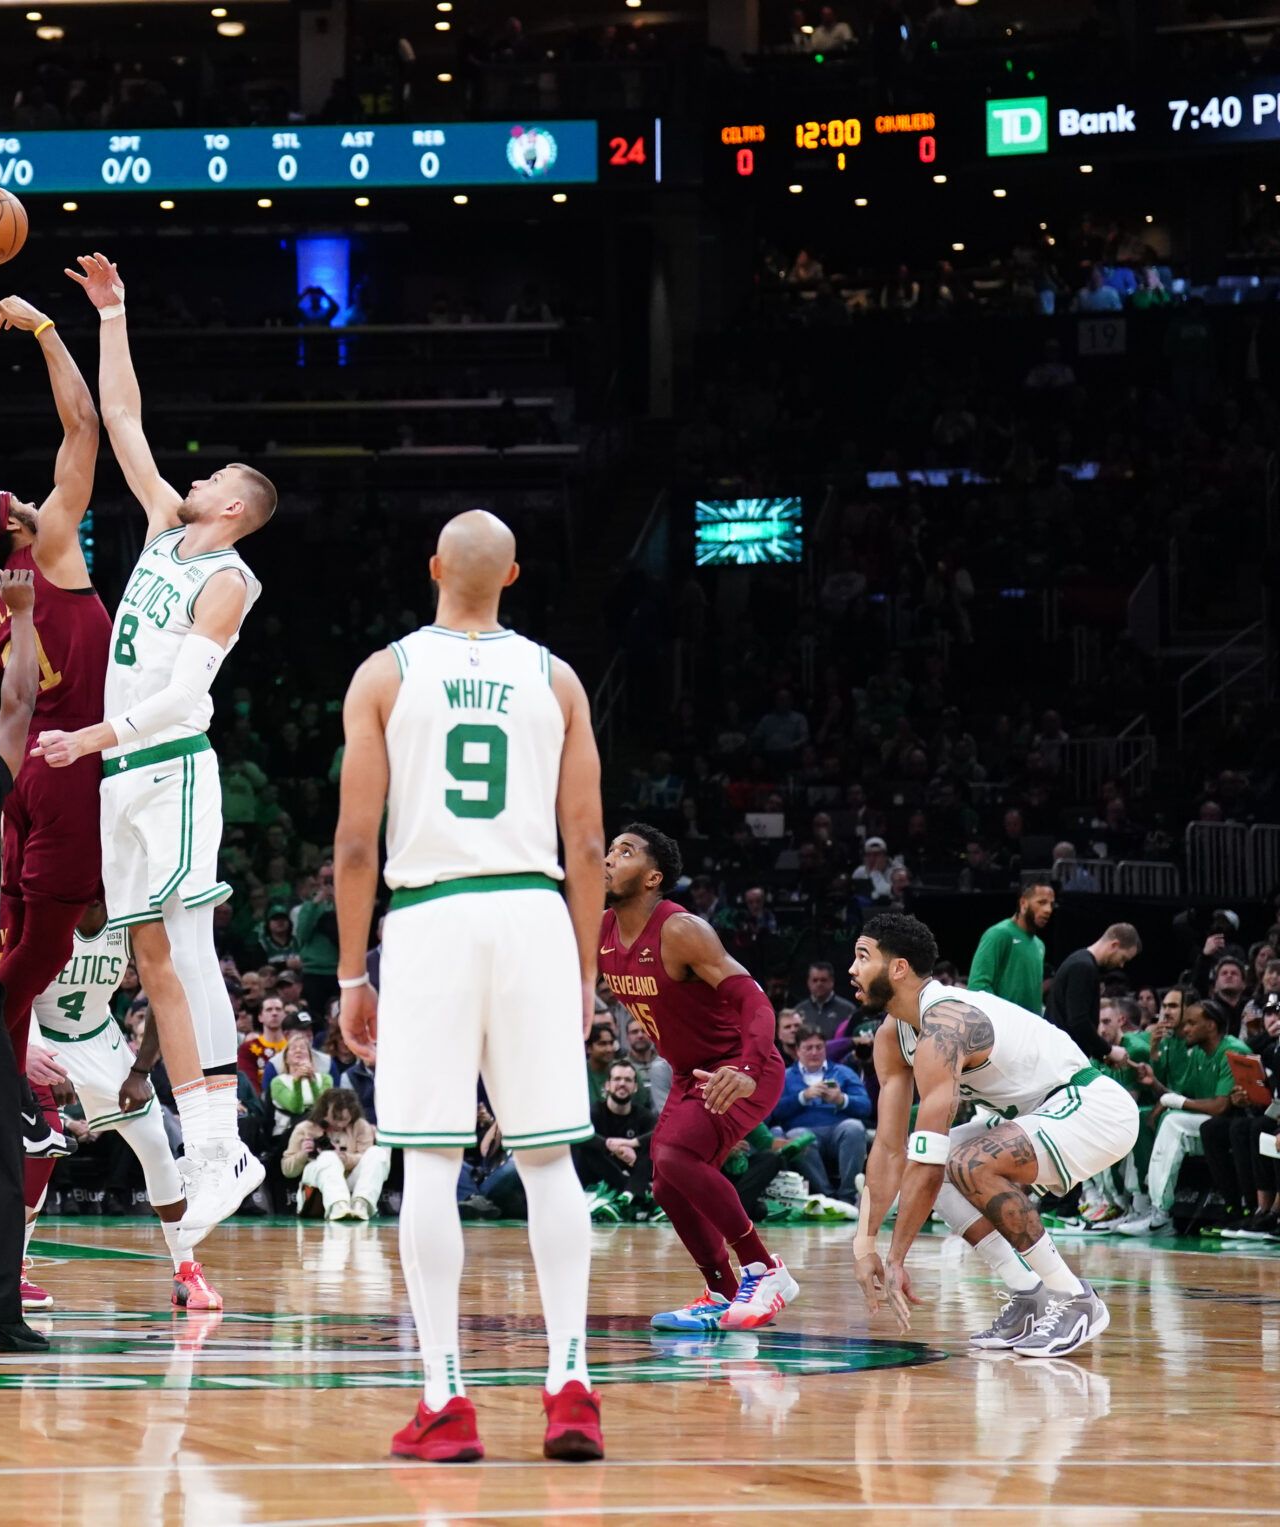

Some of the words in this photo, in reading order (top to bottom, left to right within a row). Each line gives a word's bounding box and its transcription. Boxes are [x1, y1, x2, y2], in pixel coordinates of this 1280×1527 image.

[992, 107, 1042, 145] TD
[1059, 104, 1136, 136] Bank
[1168, 96, 1243, 132] 7:40
[109, 135, 142, 152] 3PT
[204, 134, 230, 150] TO
[272, 133, 301, 150] STL
[340, 131, 375, 148] AST
[412, 129, 445, 147] REB
[795, 118, 861, 149] 12:00
[919, 135, 936, 163] 0
[608, 136, 647, 166] 24
[736, 149, 754, 176] 0
[837, 152, 846, 171] 1
[101, 155, 152, 184] 0/0
[208, 155, 228, 183] 0
[278, 154, 298, 181] 0
[349, 152, 369, 180] 0
[420, 151, 440, 179] 0
[123, 567, 181, 629] CELTICS
[114, 613, 140, 667] 8
[442, 678, 515, 715] WHITE
[445, 723, 508, 820] 9
[55, 955, 122, 985] ELTICS
[602, 972, 659, 997] CLEVELAND
[57, 991, 88, 1022] 4
[915, 1136, 927, 1154] 0
